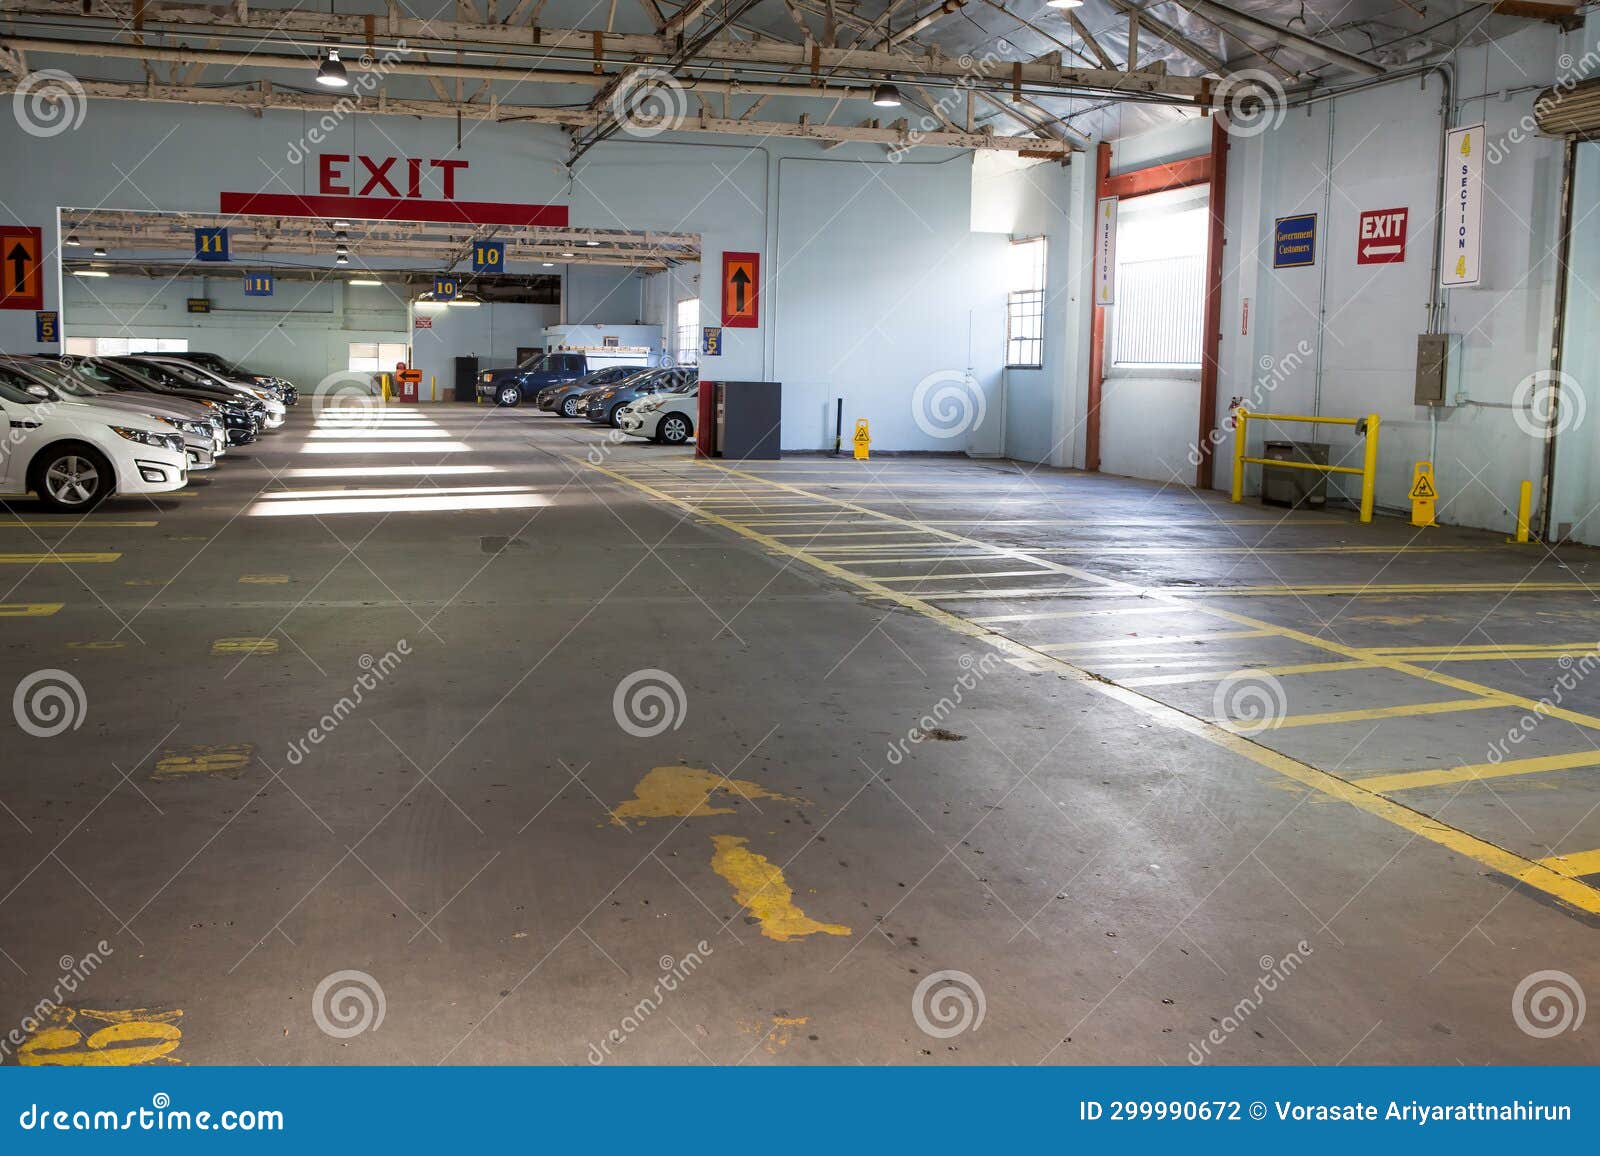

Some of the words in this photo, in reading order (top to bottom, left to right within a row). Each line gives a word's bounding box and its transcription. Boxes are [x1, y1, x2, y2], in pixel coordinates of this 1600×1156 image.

[1460, 134, 1471, 157] 4
[319, 153, 469, 199] EXIT
[1459, 165, 1468, 248] SECTION
[1361, 213, 1405, 239] EXIT
[201, 235, 222, 252] 11
[1278, 230, 1313, 241] Government
[477, 248, 499, 265] 10
[1280, 245, 1310, 255] Customers
[1456, 255, 1466, 278] 4
[256, 278, 270, 291] 11
[437, 282, 453, 295] 10
[42, 323, 54, 336] 5
[708, 338, 717, 350] 5
